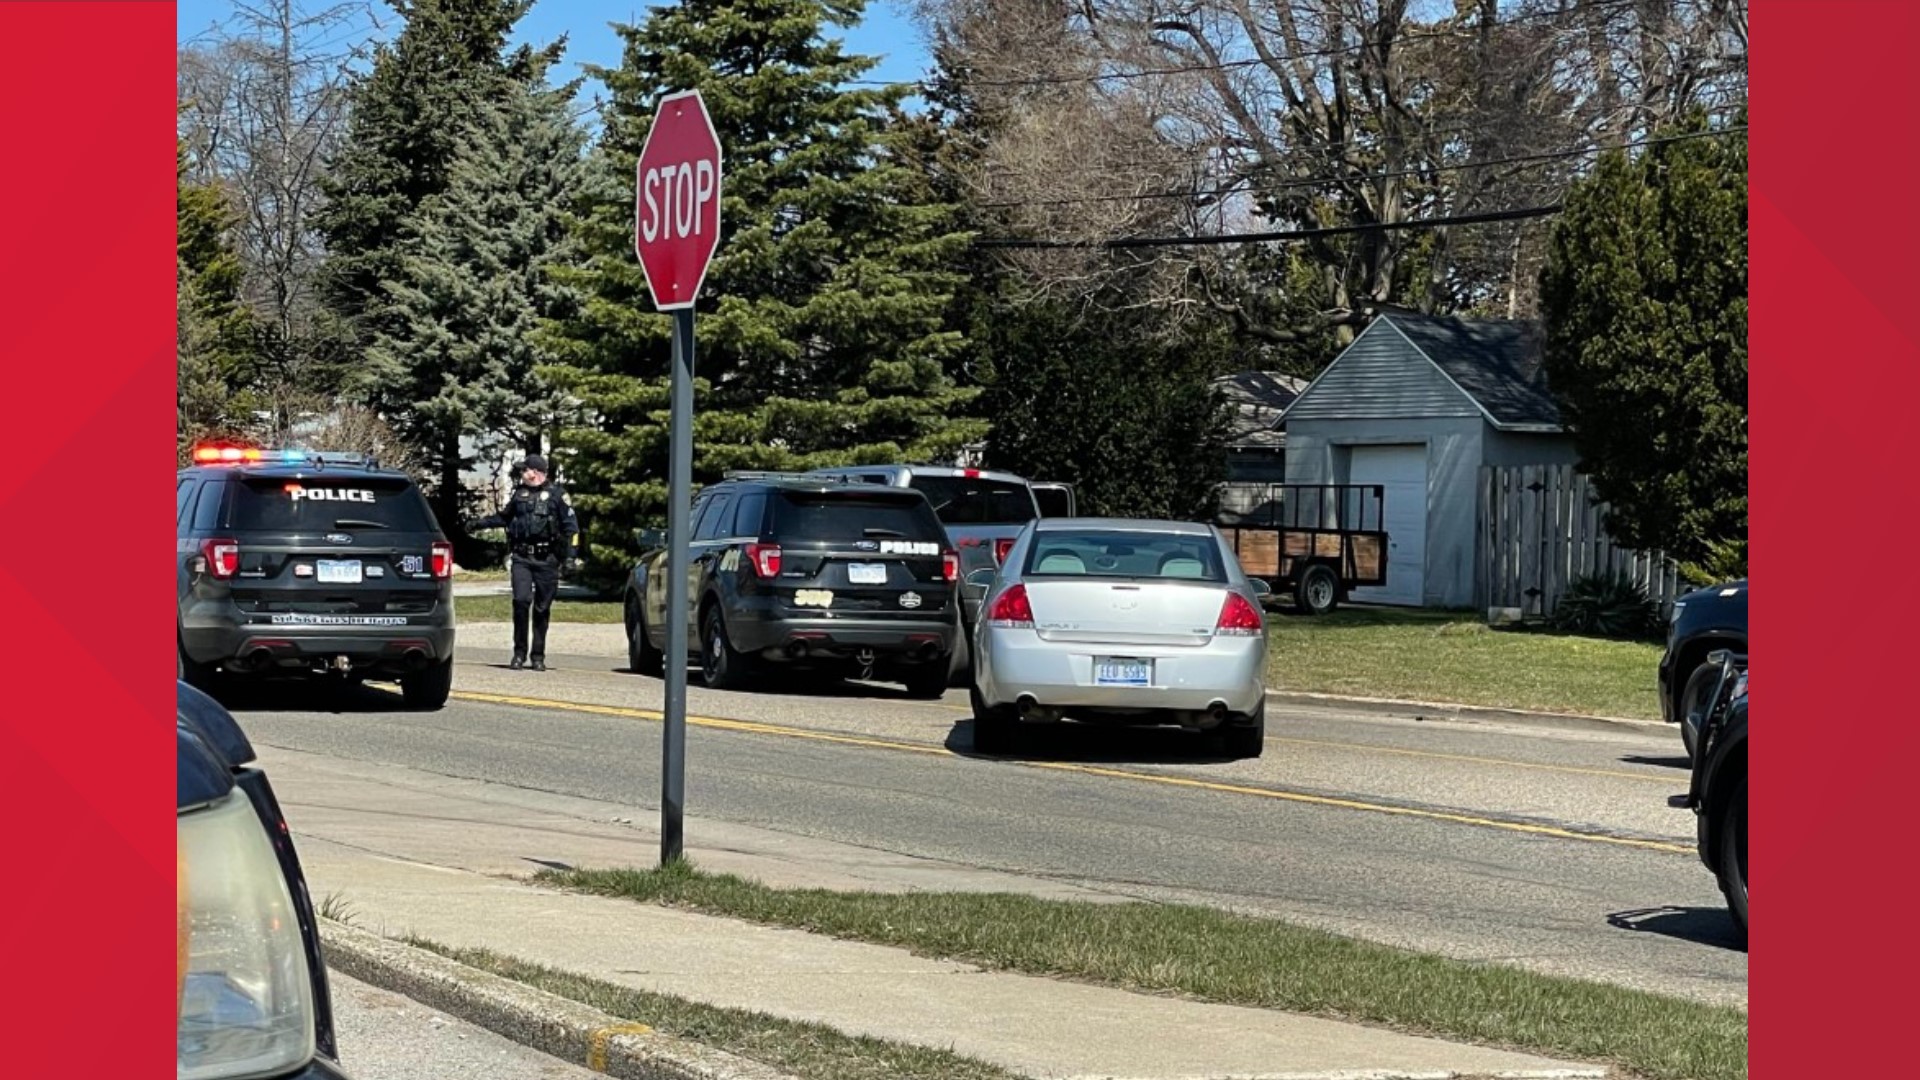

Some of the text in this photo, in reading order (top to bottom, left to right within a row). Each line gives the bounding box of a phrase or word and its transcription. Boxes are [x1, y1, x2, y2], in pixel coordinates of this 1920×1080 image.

[642, 159, 714, 243] STOP
[291, 488, 376, 503] POLICE
[402, 555, 423, 573] 51
